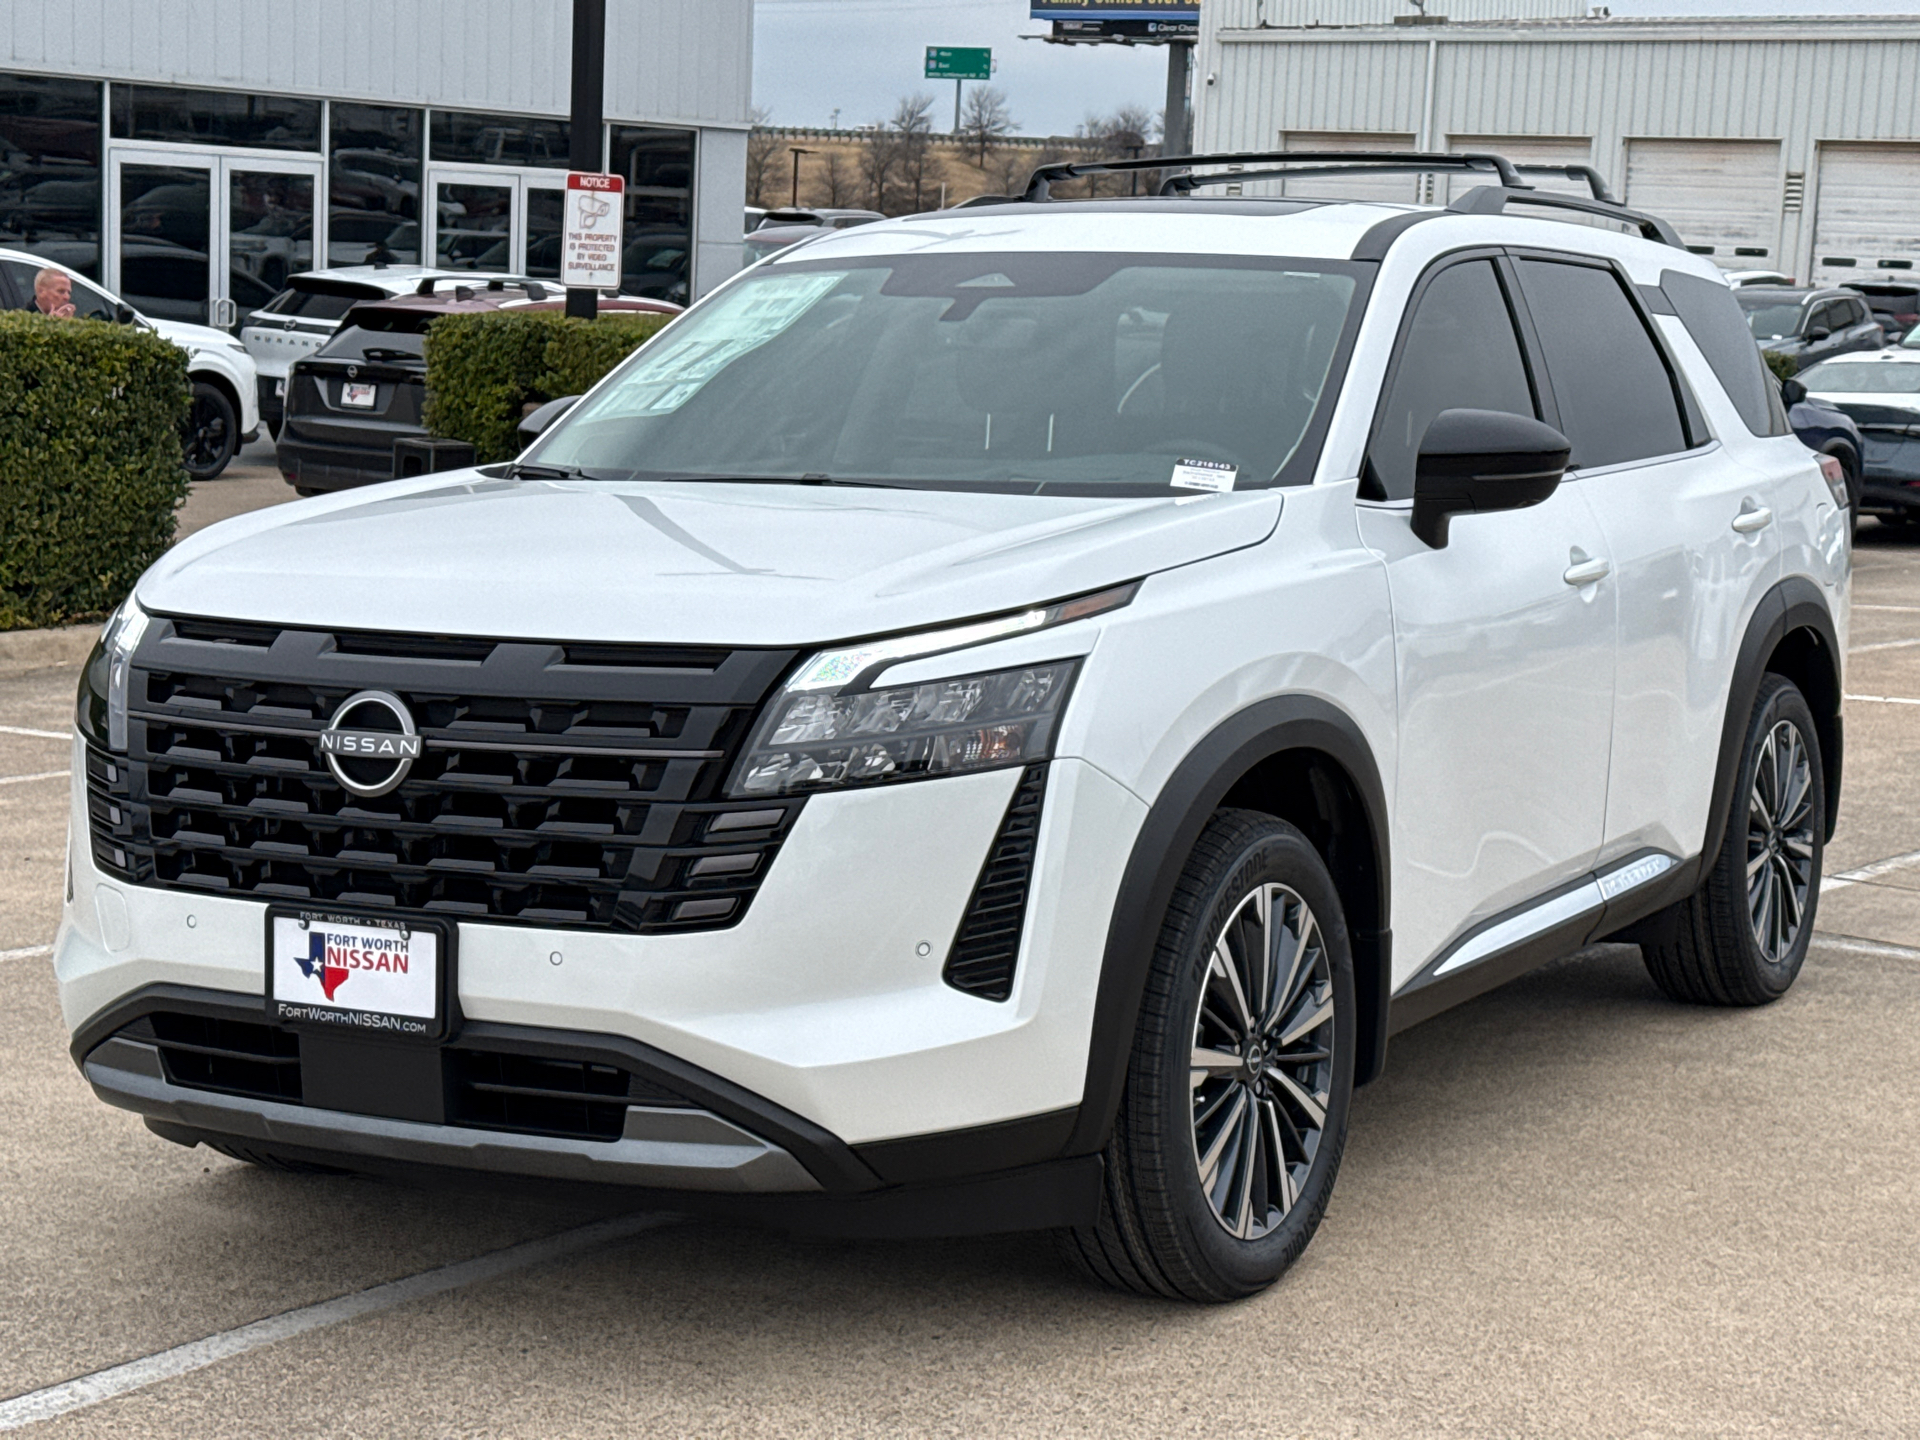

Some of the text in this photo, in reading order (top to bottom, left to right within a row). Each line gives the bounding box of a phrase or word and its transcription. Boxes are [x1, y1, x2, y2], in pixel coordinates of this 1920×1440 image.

[579, 177, 610, 188] NOTICE
[568, 232, 617, 242] THIS PROPERTY
[569, 242, 615, 252] IS PROTECTED
[587, 253, 606, 261] VIDEO
[568, 262, 615, 271] SURVEILLANCE
[320, 733, 418, 755] NISSAN
[300, 911, 407, 930] FORT WORTH TEXAS
[326, 932, 409, 953] FORT WORTH
[326, 946, 409, 974] NISSAN
